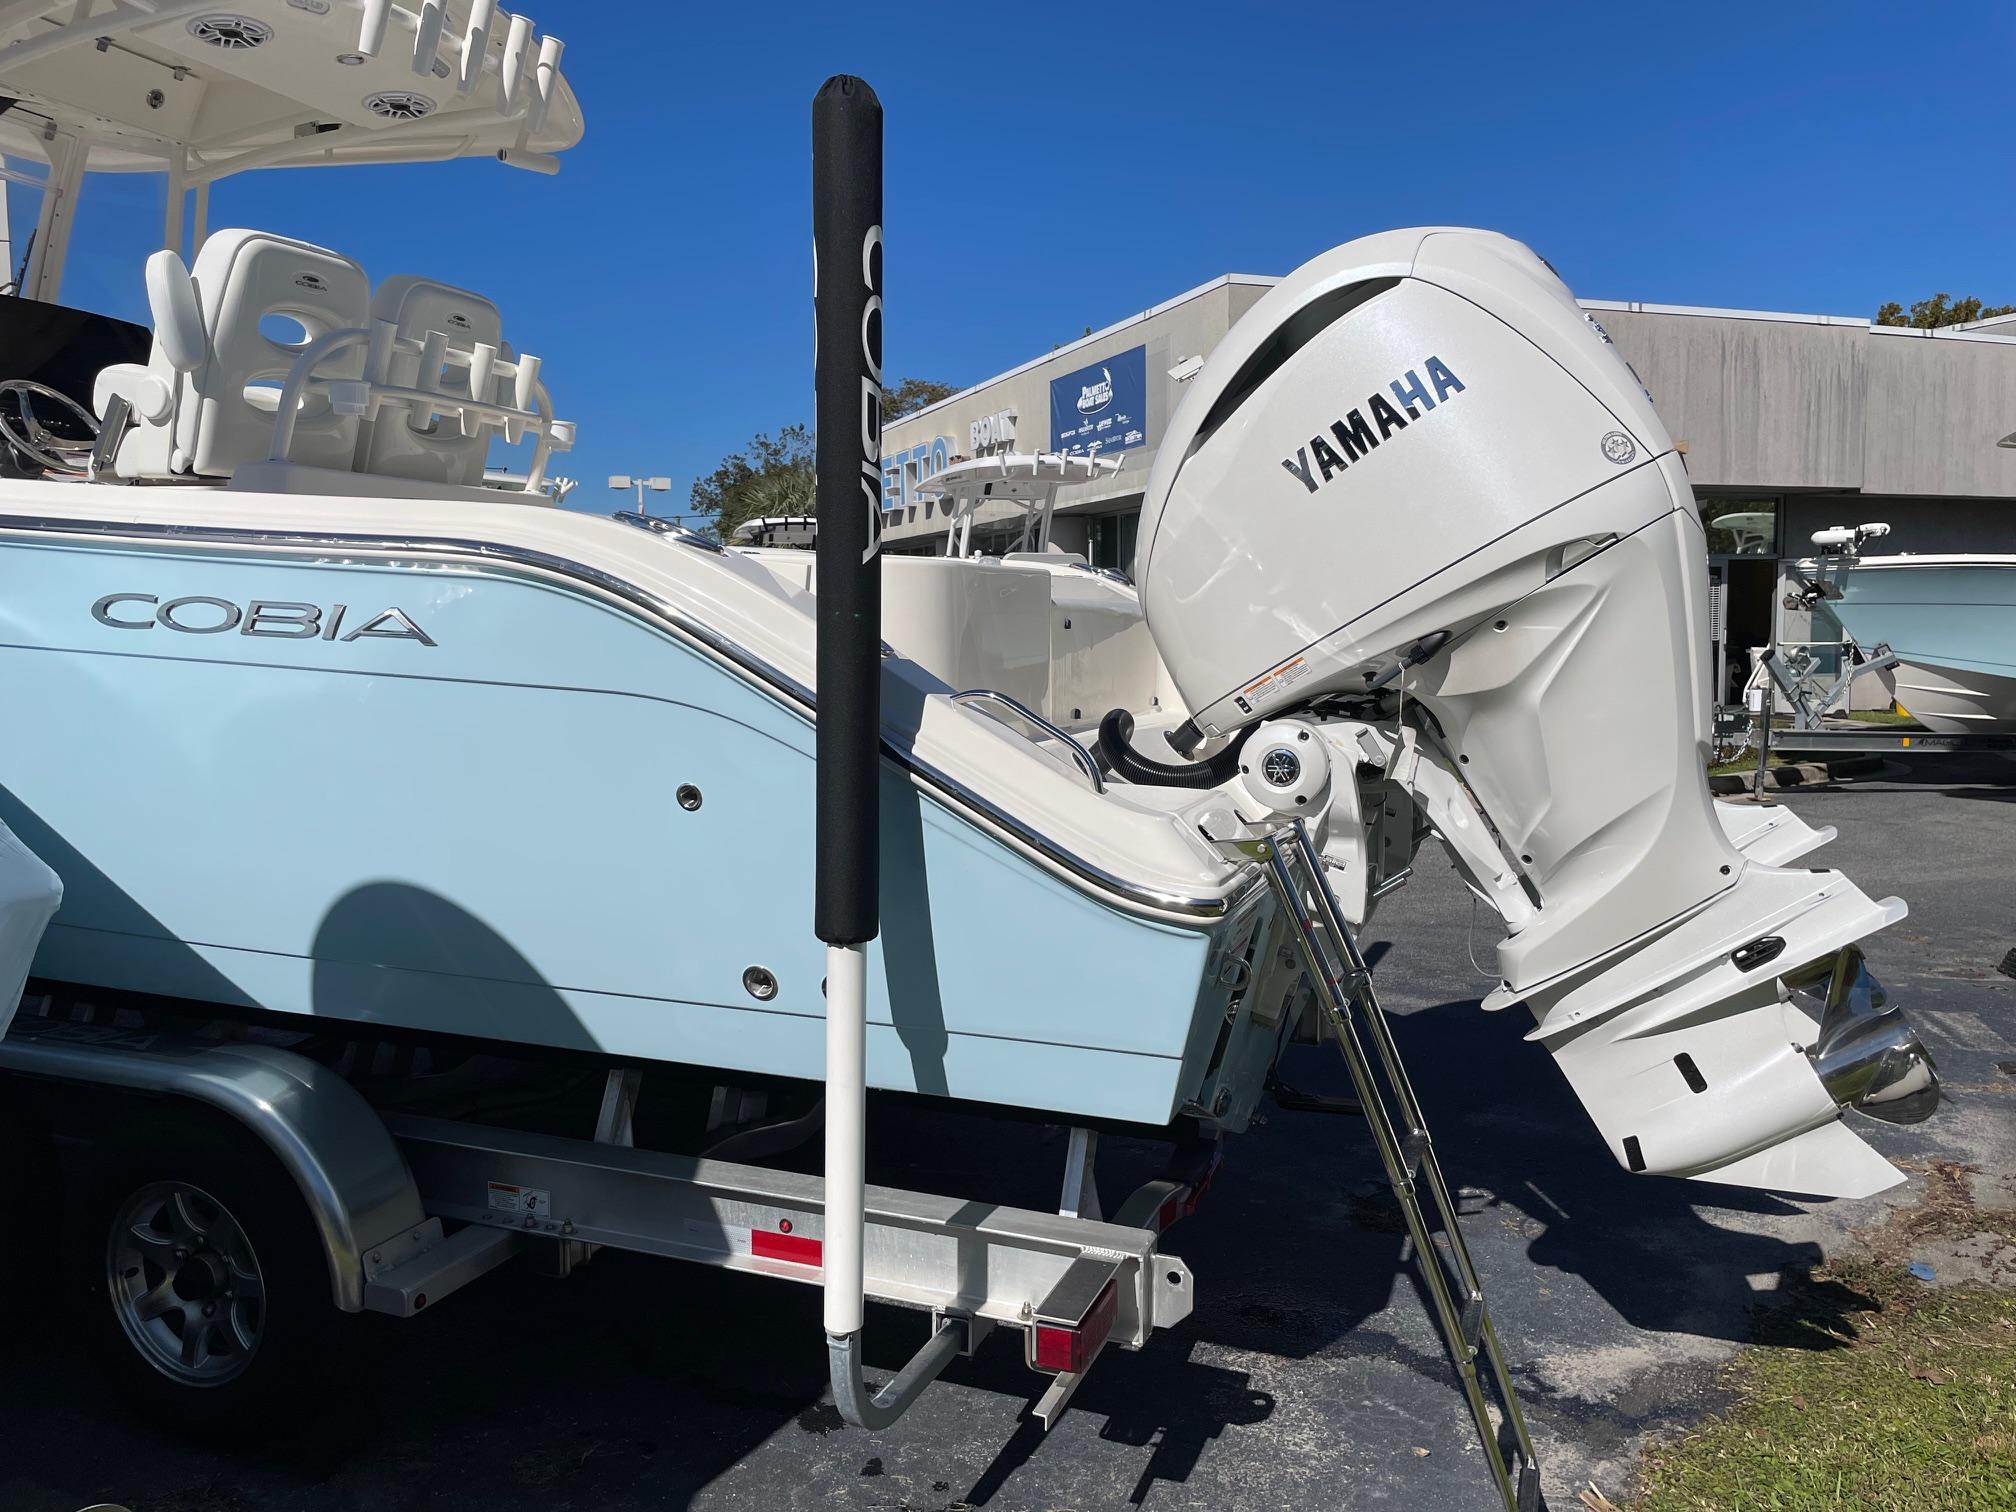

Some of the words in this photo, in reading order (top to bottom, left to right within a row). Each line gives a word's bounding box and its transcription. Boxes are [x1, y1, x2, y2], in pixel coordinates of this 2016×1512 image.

[295, 280, 328, 292] COBIA
[447, 319, 472, 330] COBIA
[1094, 391, 1109, 405] SALES
[969, 408, 1013, 451] BOAT
[1281, 355, 1466, 494] YAMAHA
[90, 592, 439, 648] COBIA
